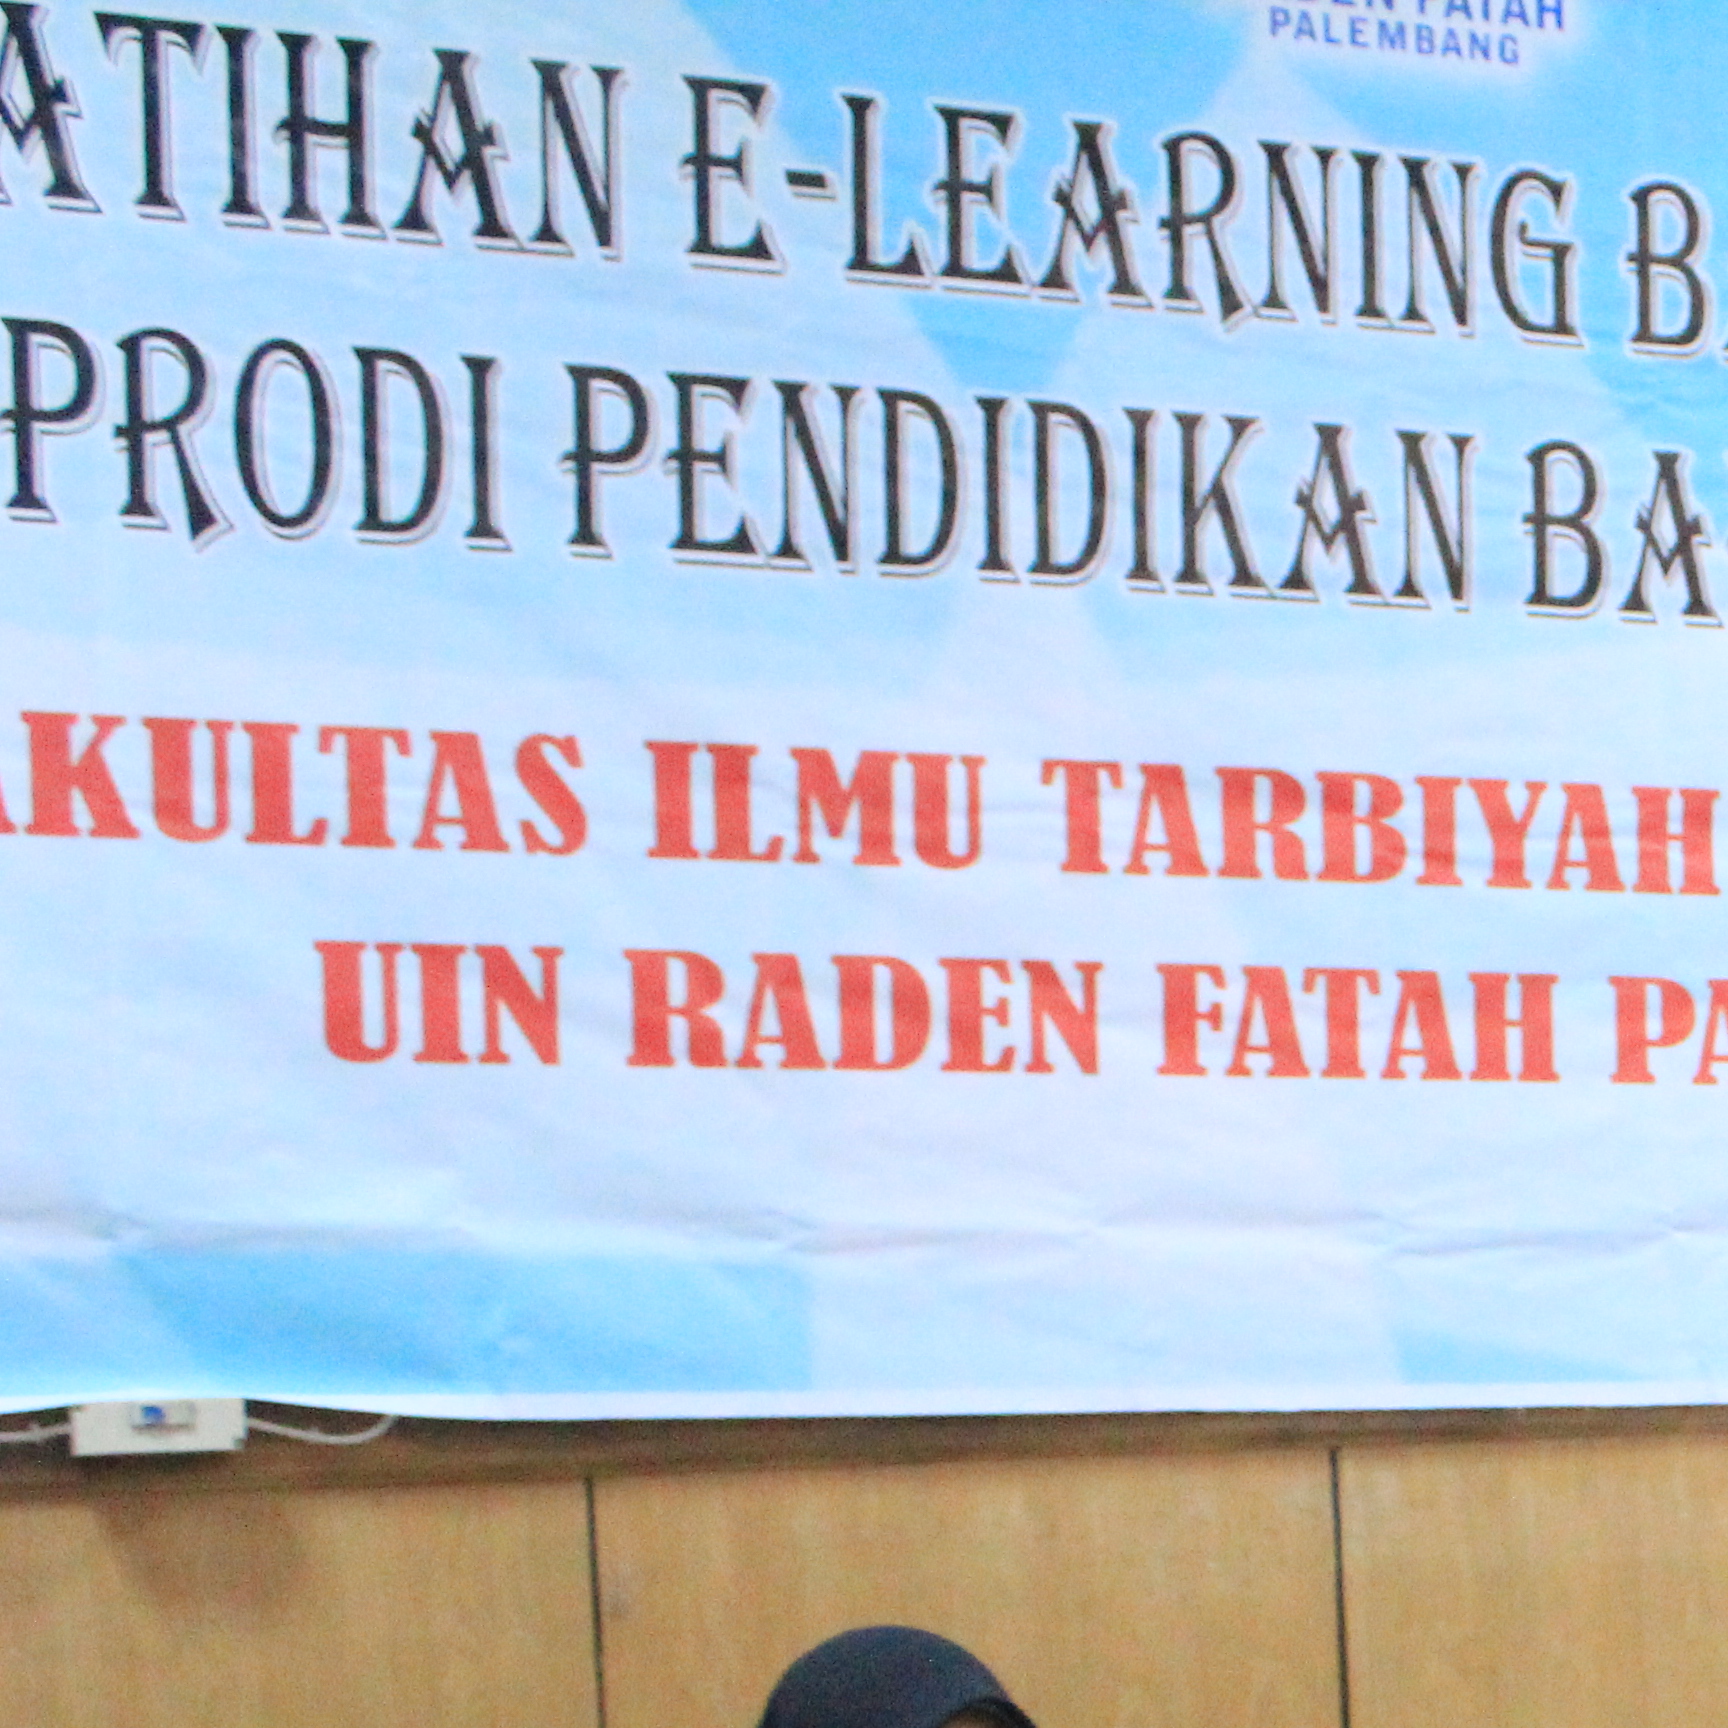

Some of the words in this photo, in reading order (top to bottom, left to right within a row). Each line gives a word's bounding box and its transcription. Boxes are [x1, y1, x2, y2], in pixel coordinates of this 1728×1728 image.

[1267, 5, 1521, 66] PALEMBANG
[0, 2, 622, 252] ATIHAN
[683, 75, 1584, 347] E-LEARNING
[0, 317, 506, 545] PRODI
[562, 364, 1473, 604] PENDIDIKAN
[0, 710, 589, 856] KULTAS
[647, 741, 985, 869] ILMU
[1042, 760, 1721, 895] TARBIYAH
[315, 941, 563, 1065] UIN
[624, 950, 1104, 1075] RADEN
[1157, 964, 1559, 1083] FATAH
